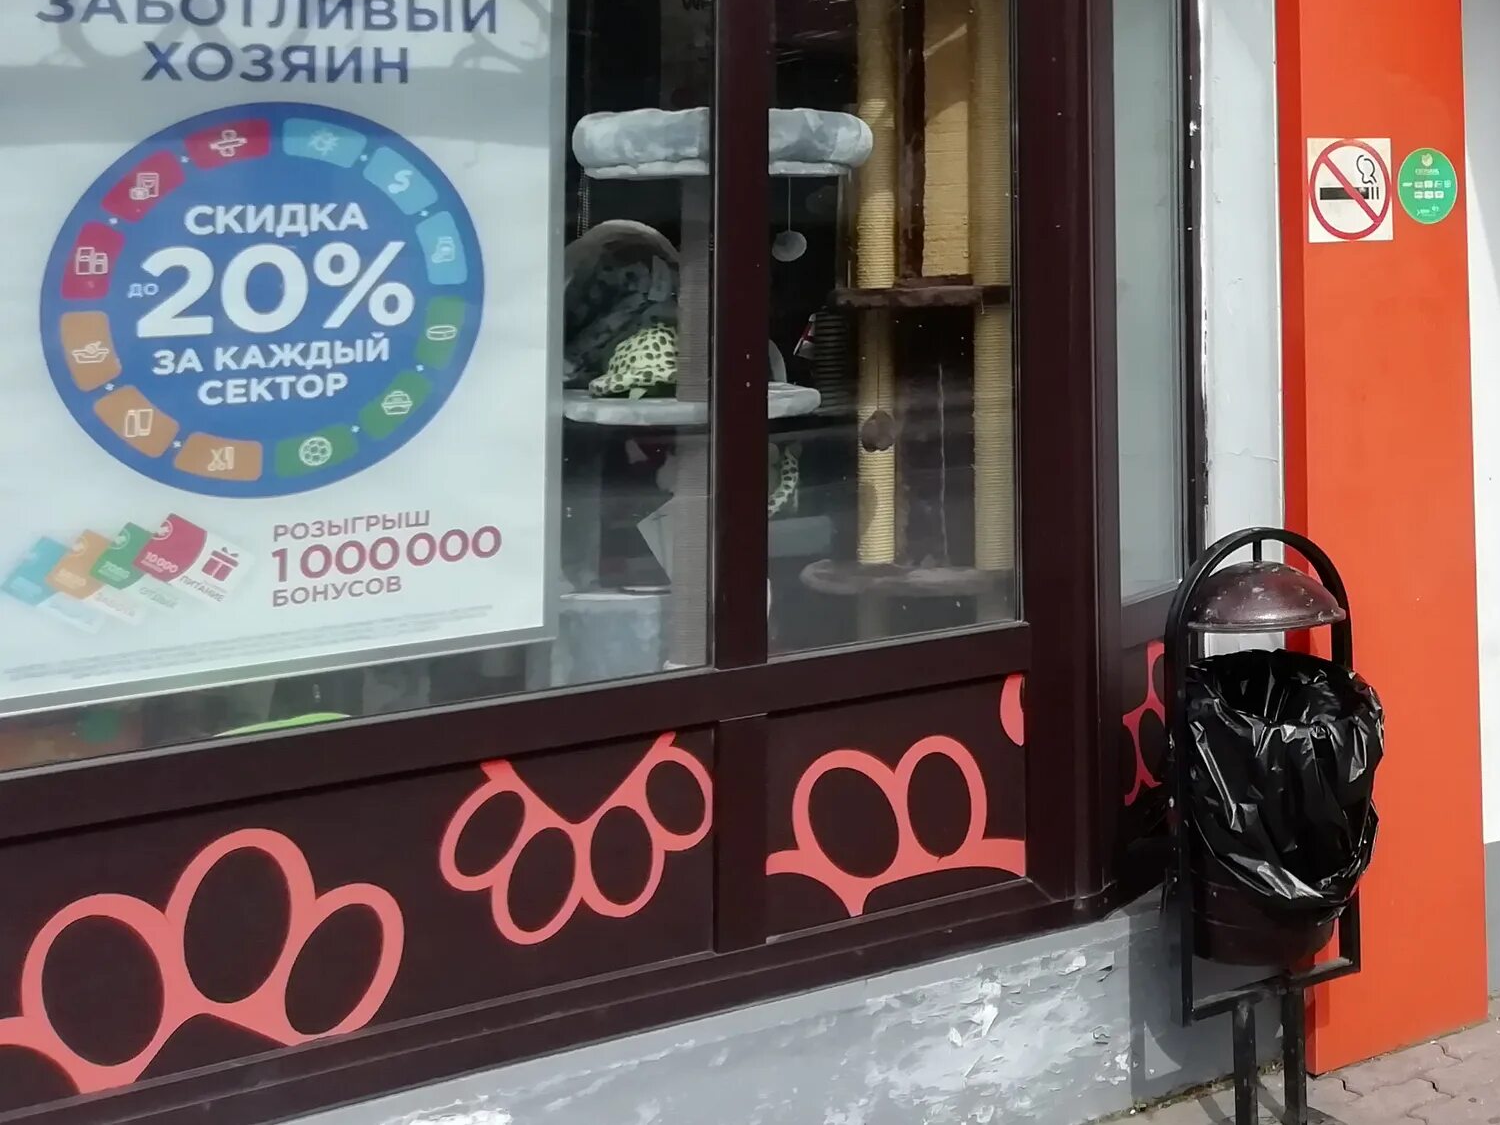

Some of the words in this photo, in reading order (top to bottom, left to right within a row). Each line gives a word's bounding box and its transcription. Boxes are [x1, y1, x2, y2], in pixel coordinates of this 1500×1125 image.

[141, 40, 409, 85] ХОЗЯИН
[183, 202, 369, 238] СКИДКА
[136, 241, 415, 338] 20%
[152, 348, 204, 376] ЗА
[214, 332, 390, 371] КАЖДЫЙ
[197, 372, 348, 406] СЕКТОР
[272, 509, 431, 542] РОЗЫГРЫШ
[272, 575, 403, 608] БОНУСОВ
